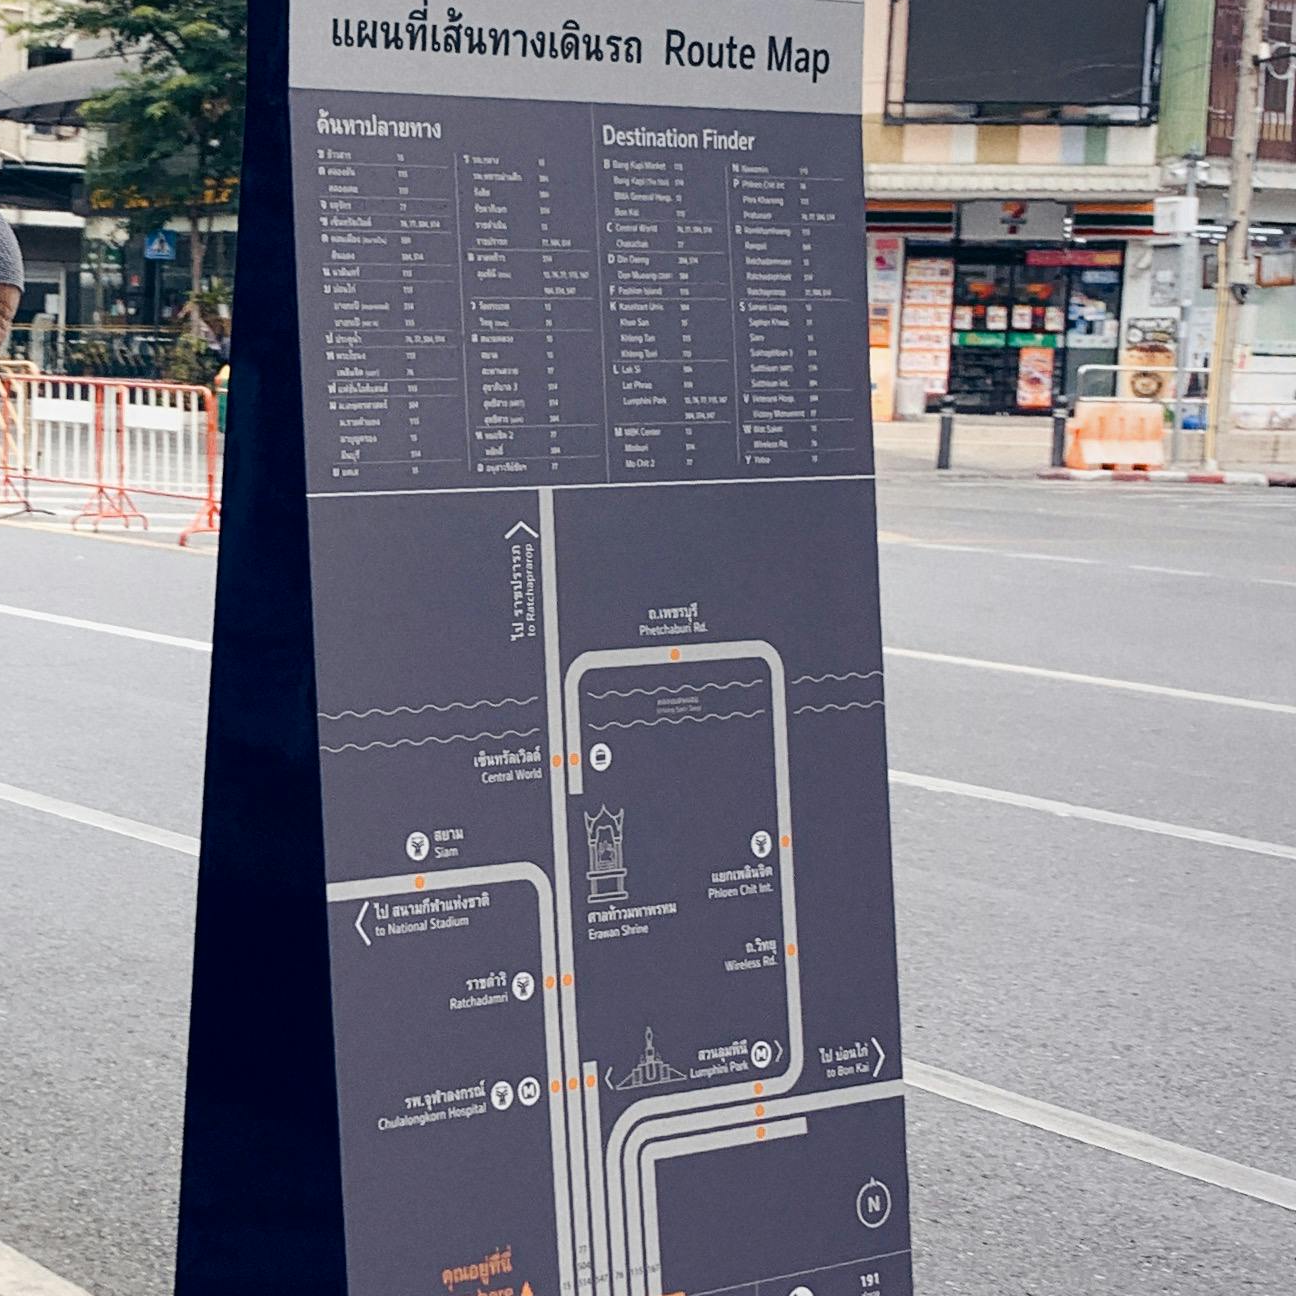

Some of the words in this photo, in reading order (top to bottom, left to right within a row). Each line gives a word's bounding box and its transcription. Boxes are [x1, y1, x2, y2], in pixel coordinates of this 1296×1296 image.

[665, 28, 757, 72] Route
[766, 35, 830, 83] Map
[317, 109, 441, 139] ค้นหาปลายทาง
[602, 124, 699, 149] Destination
[703, 128, 756, 151] Finder
[606, 222, 613, 232] C
[607, 254, 615, 264] D
[609, 285, 615, 295] F
[610, 301, 617, 311] K
[739, 302, 745, 312] S
[613, 364, 619, 374] L
[510, 622, 525, 642] ไป
[527, 624, 536, 637] to
[639, 623, 692, 636] Phetchaburi
[481, 770, 514, 784] Central
[515, 767, 543, 780] World
[434, 829, 464, 842] สยาม
[434, 847, 459, 859] Siam
[373, 902, 389, 920] ไป
[375, 926, 386, 937] to
[387, 919, 428, 935] National
[429, 916, 470, 930] Stadium
[588, 928, 621, 940] Erawan
[621, 923, 649, 936] Shrine
[724, 959, 762, 971] Wireless
[762, 954, 778, 966] Rd.
[449, 992, 509, 1010] Ratchadamri
[818, 1047, 833, 1064] ไป
[690, 1063, 729, 1079] Lumphini
[729, 1060, 749, 1072] Park
[826, 1069, 836, 1078] to
[377, 1109, 447, 1130] Chulalongkorn
[448, 1102, 487, 1119] Hospital
[867, 1195, 881, 1213] N
[442, 1244, 512, 1292] คุณอยู่ที่นี่
[860, 1272, 880, 1287] 191
